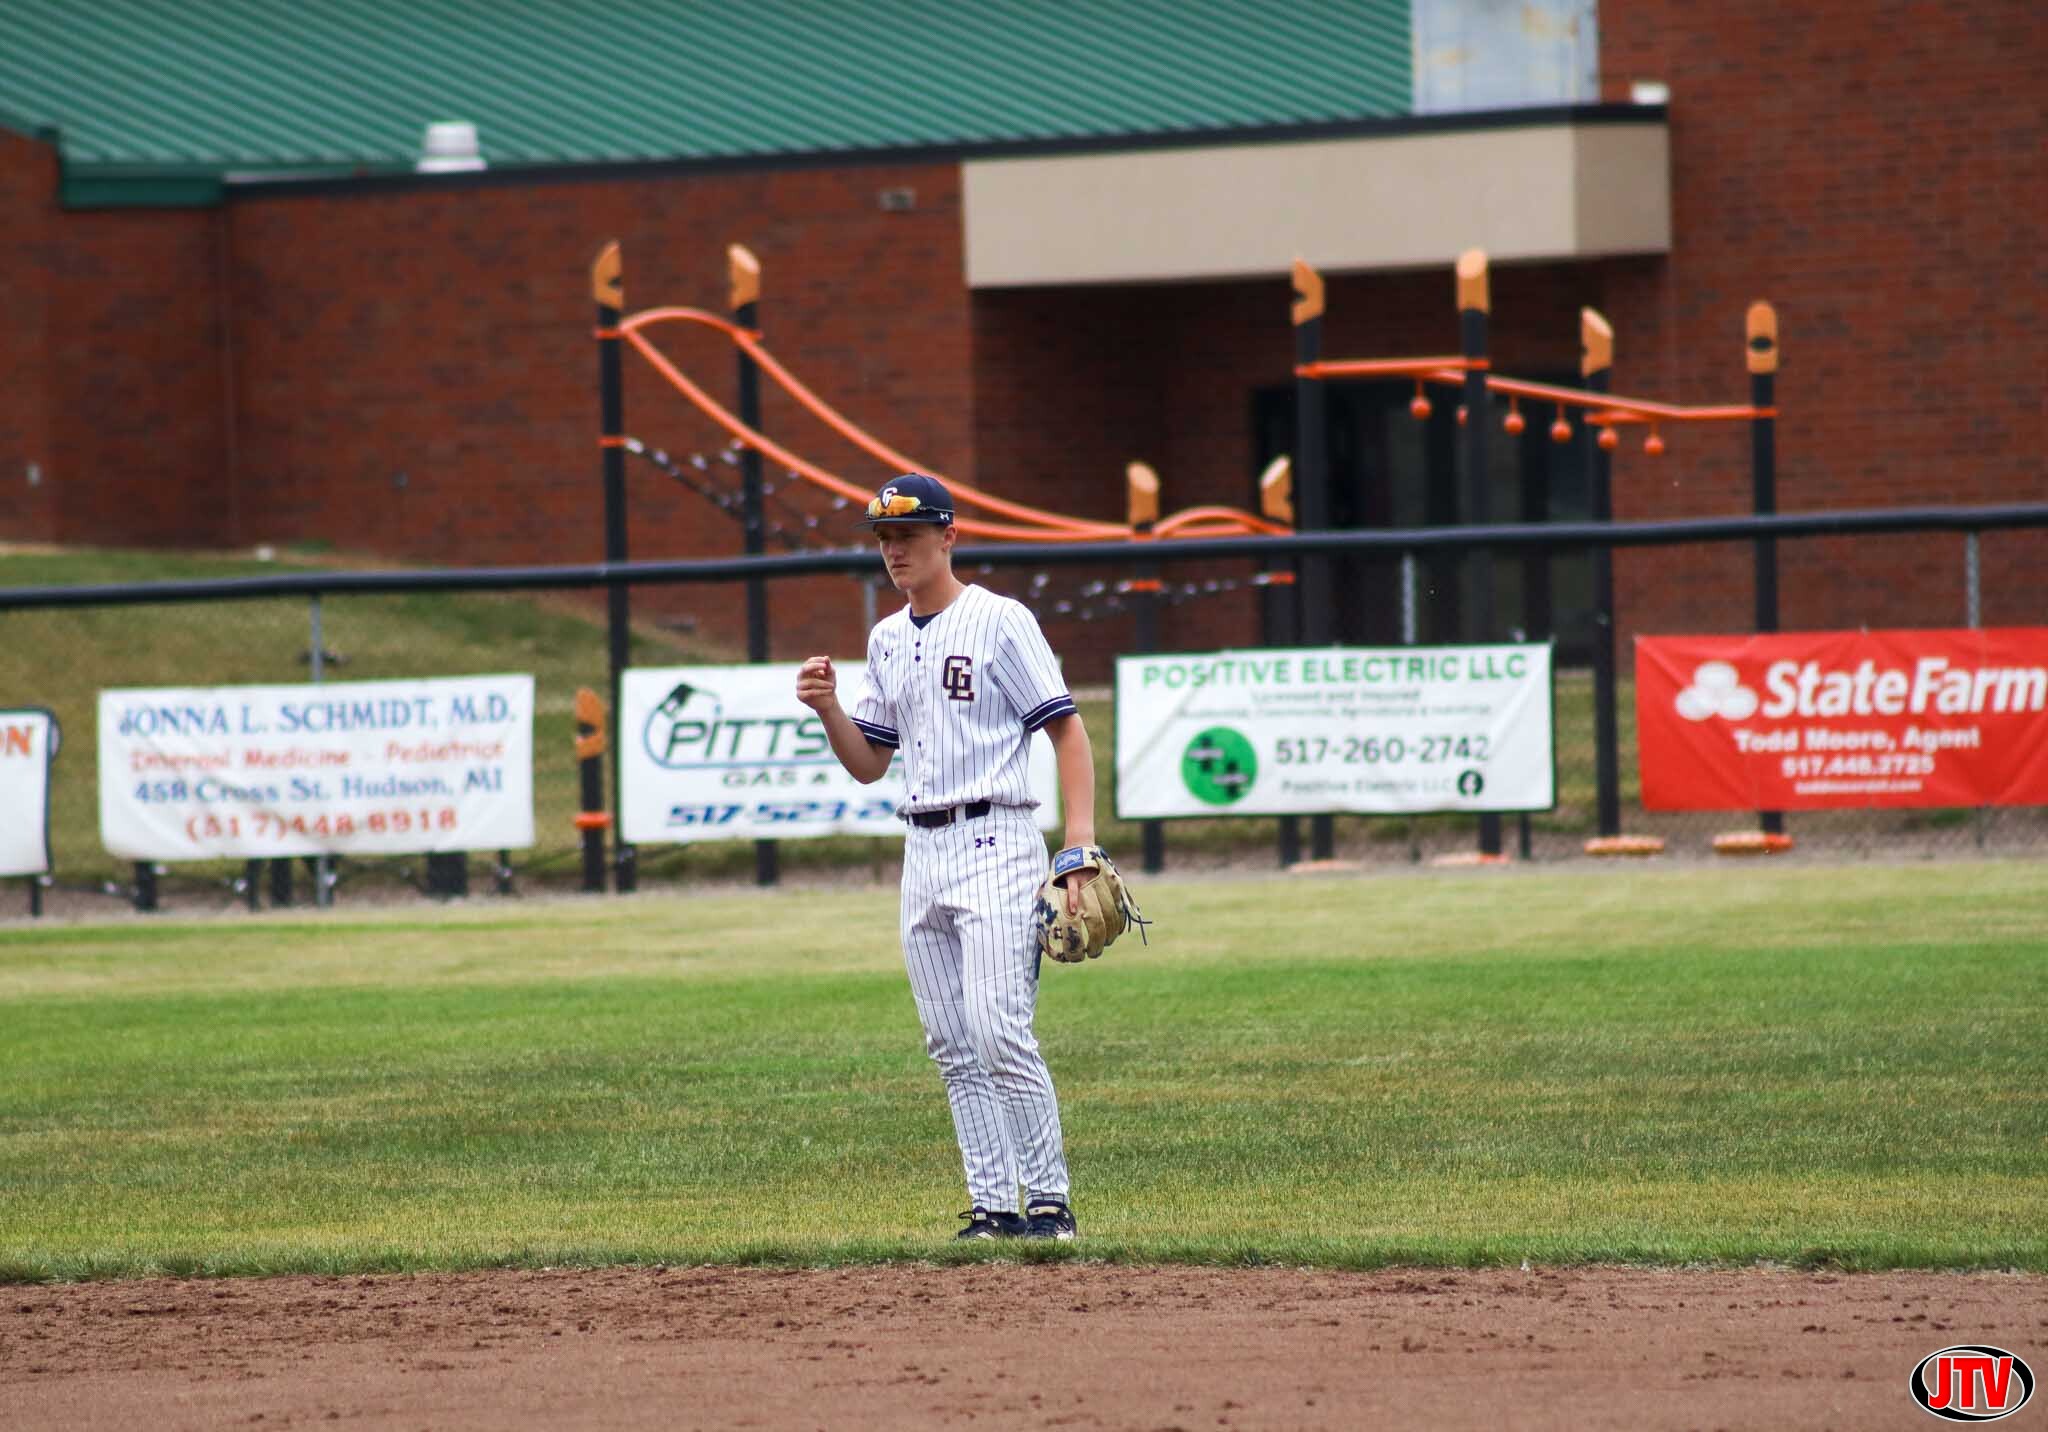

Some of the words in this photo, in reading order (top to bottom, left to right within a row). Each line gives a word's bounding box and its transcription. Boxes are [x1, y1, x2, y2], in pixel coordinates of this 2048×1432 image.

[1141, 657, 1292, 690] POSITIVE
[1301, 654, 1460, 684] ELECTRIC
[1467, 651, 1528, 682] LLC
[664, 704, 830, 761] PITTS
[1274, 734, 1490, 765] 517-260-2742
